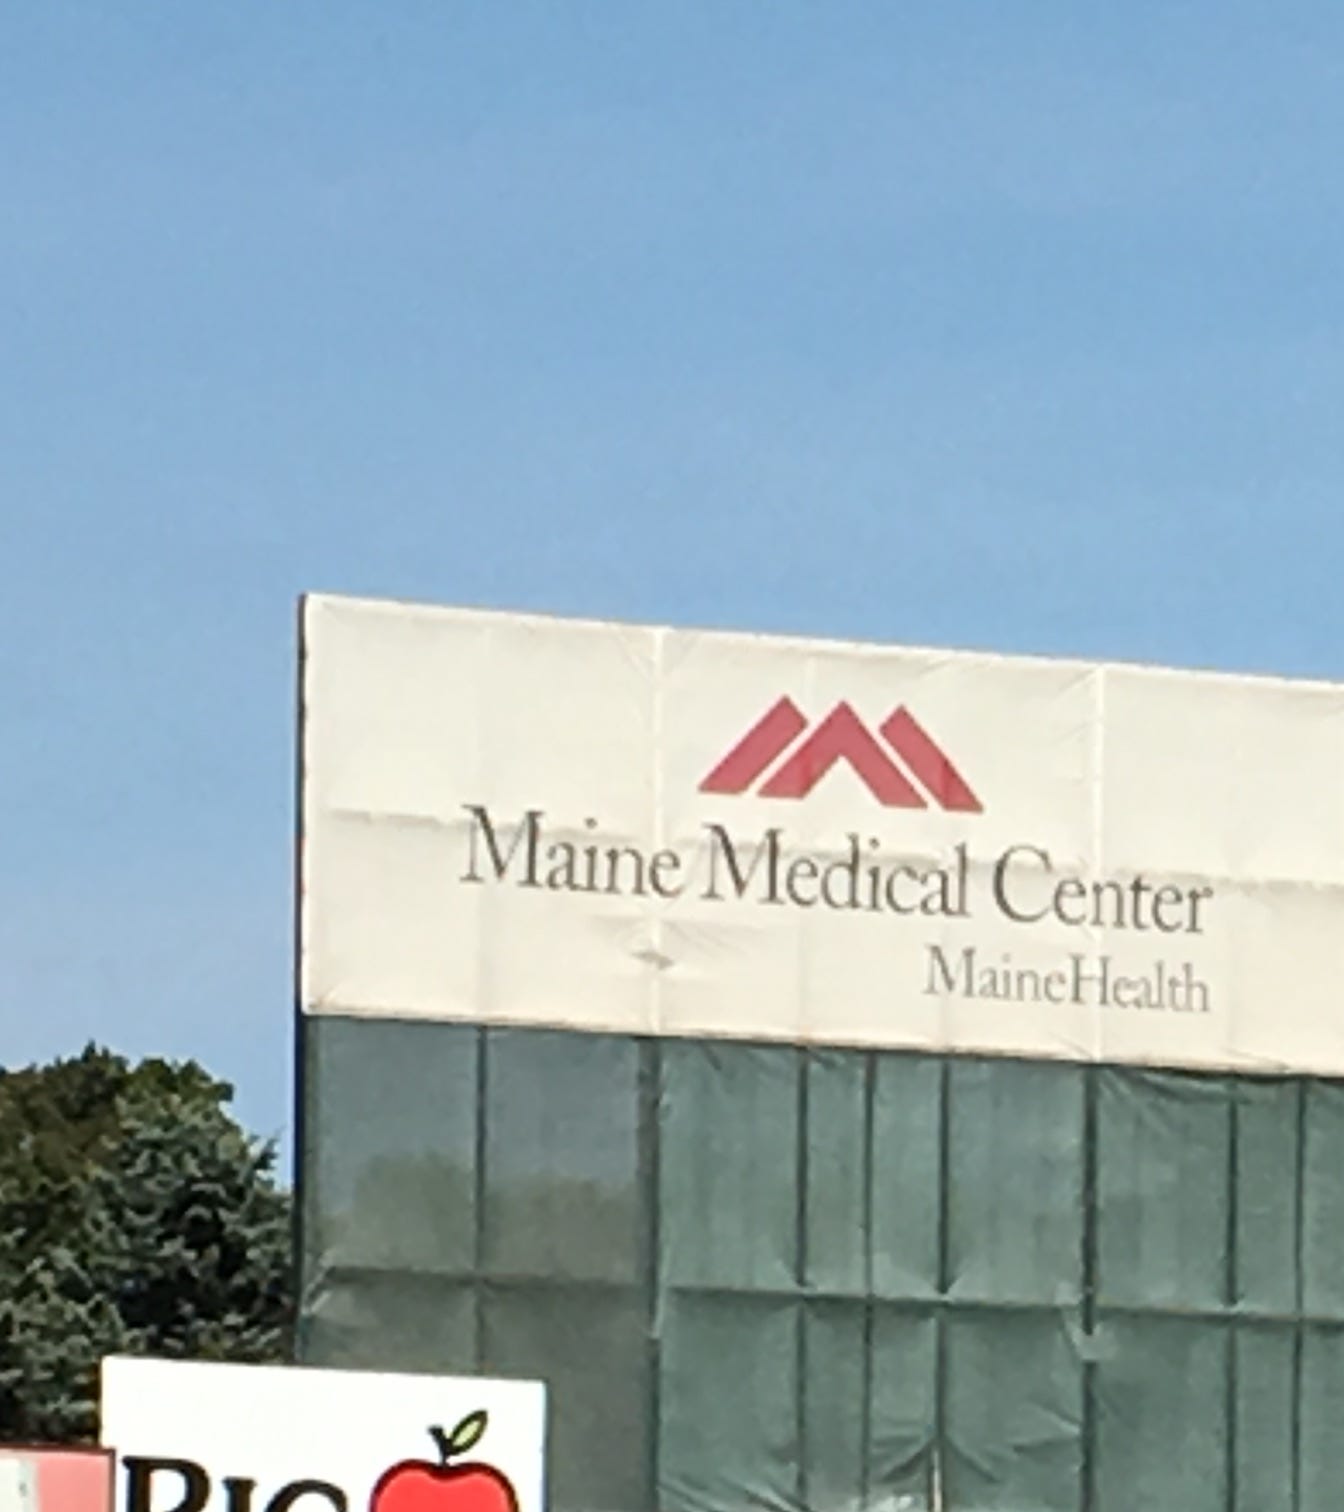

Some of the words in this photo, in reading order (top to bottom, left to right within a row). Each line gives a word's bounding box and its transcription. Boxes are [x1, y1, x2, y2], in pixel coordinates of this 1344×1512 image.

[460, 804, 685, 898] Maine
[701, 822, 971, 918] Medical
[992, 844, 1214, 934] Center
[923, 944, 1211, 1013] MaineHealth
